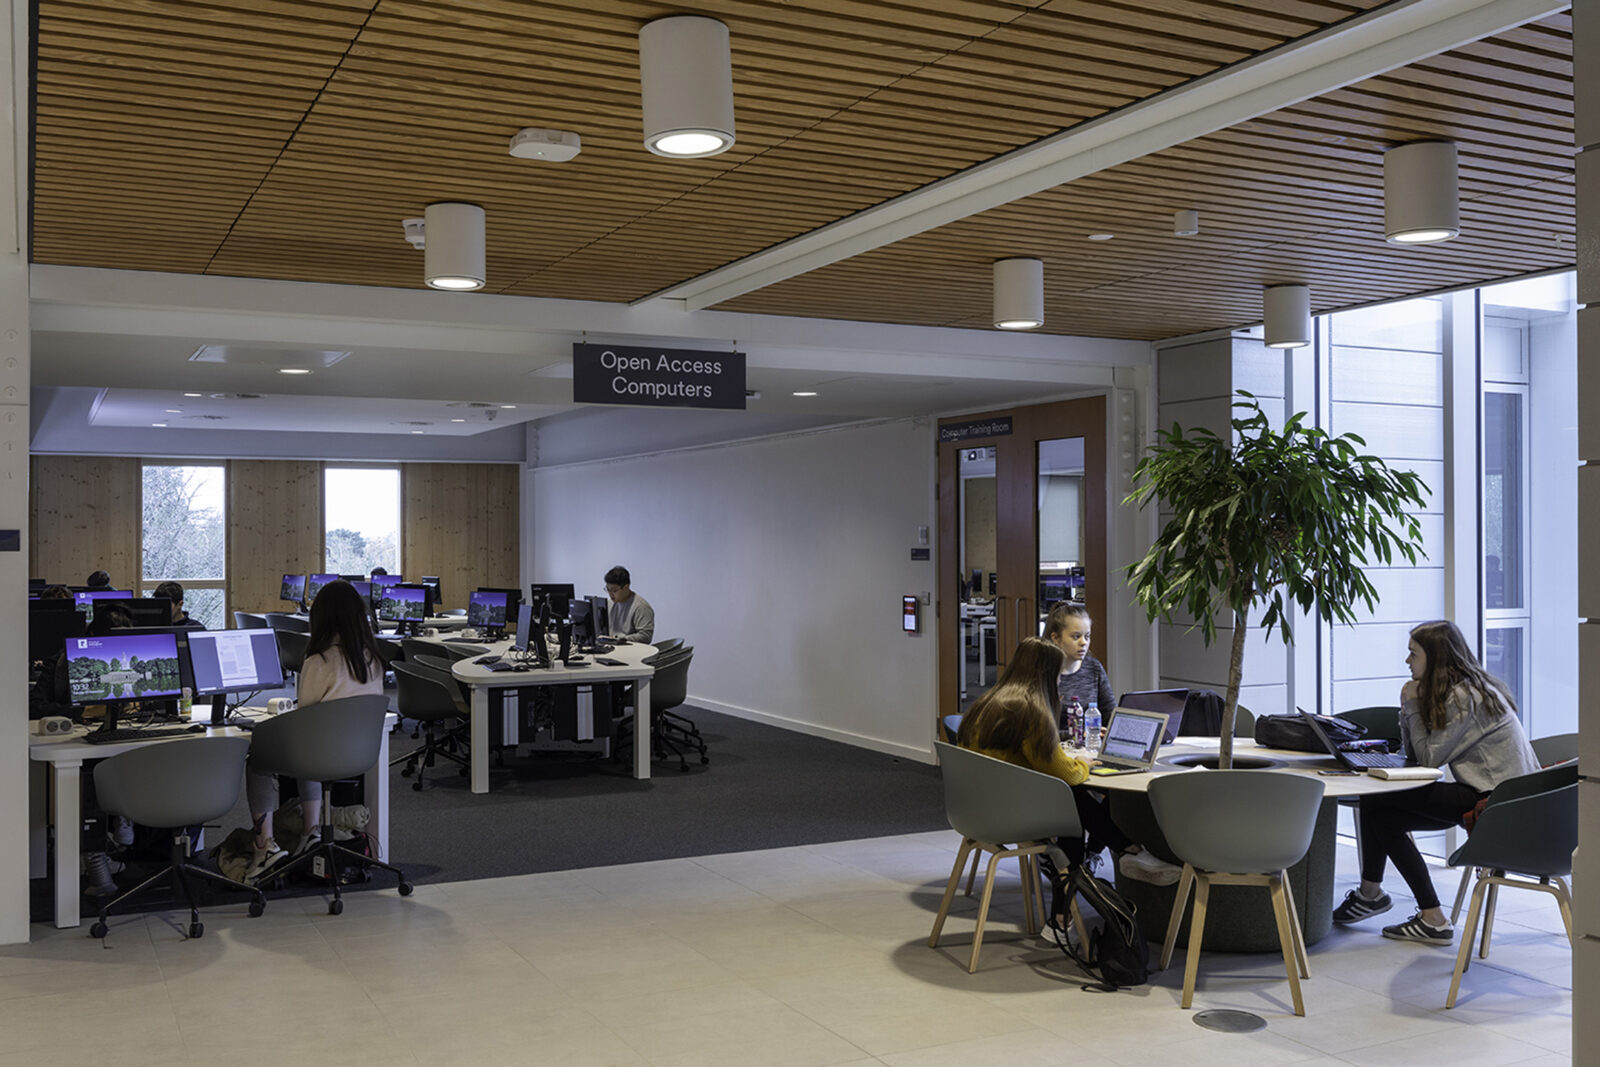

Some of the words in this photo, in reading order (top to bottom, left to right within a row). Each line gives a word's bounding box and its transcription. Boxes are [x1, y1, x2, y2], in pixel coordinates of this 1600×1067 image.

[601, 351, 651, 373] Open
[656, 354, 722, 374] Access
[612, 376, 712, 399] Computers
[968, 424, 991, 435] Training
[991, 422, 1009, 432] Room
